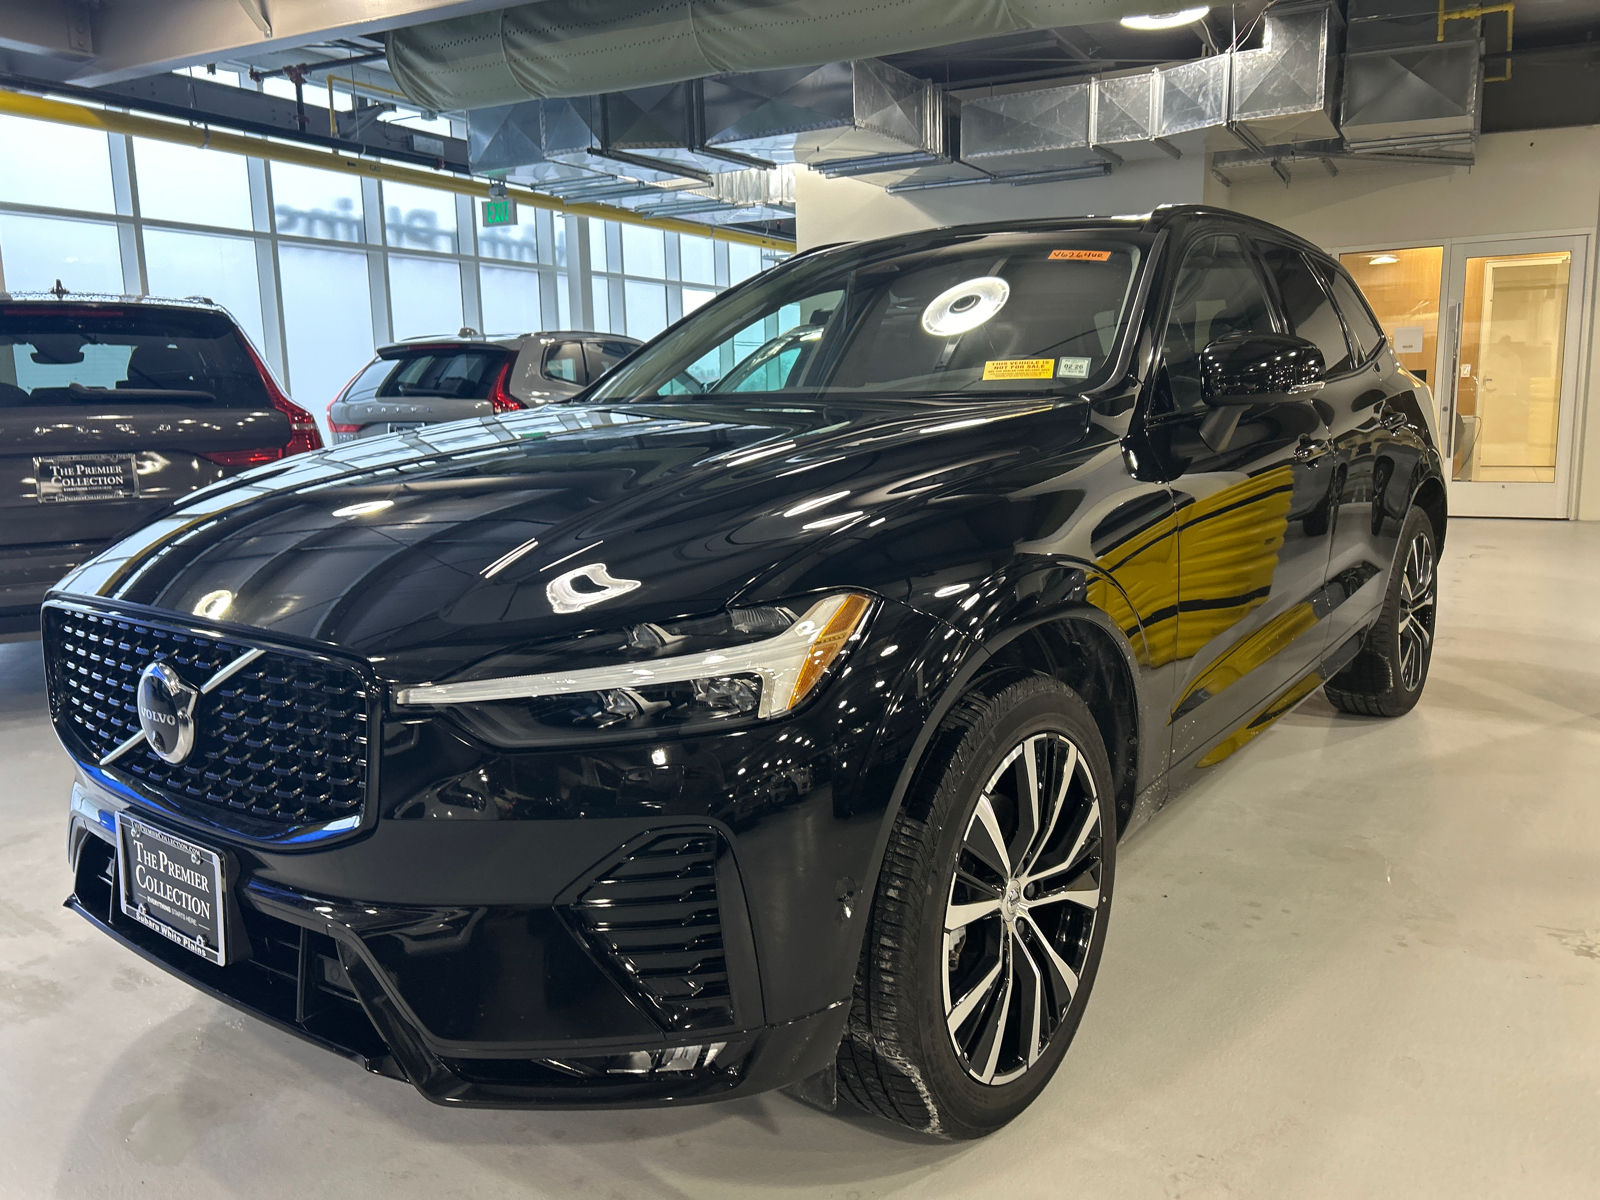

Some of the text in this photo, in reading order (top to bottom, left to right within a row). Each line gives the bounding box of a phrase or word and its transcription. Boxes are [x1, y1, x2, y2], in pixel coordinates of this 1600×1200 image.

[487, 201, 508, 223] EXIT
[49, 464, 123, 476] THE PREMIER
[50, 475, 124, 487] COLLECTION
[140, 705, 176, 726] VOLVO
[133, 839, 210, 893] THE PREMIER
[135, 864, 211, 920] COLLECTION
[135, 911, 207, 957] Subaru White Plains
